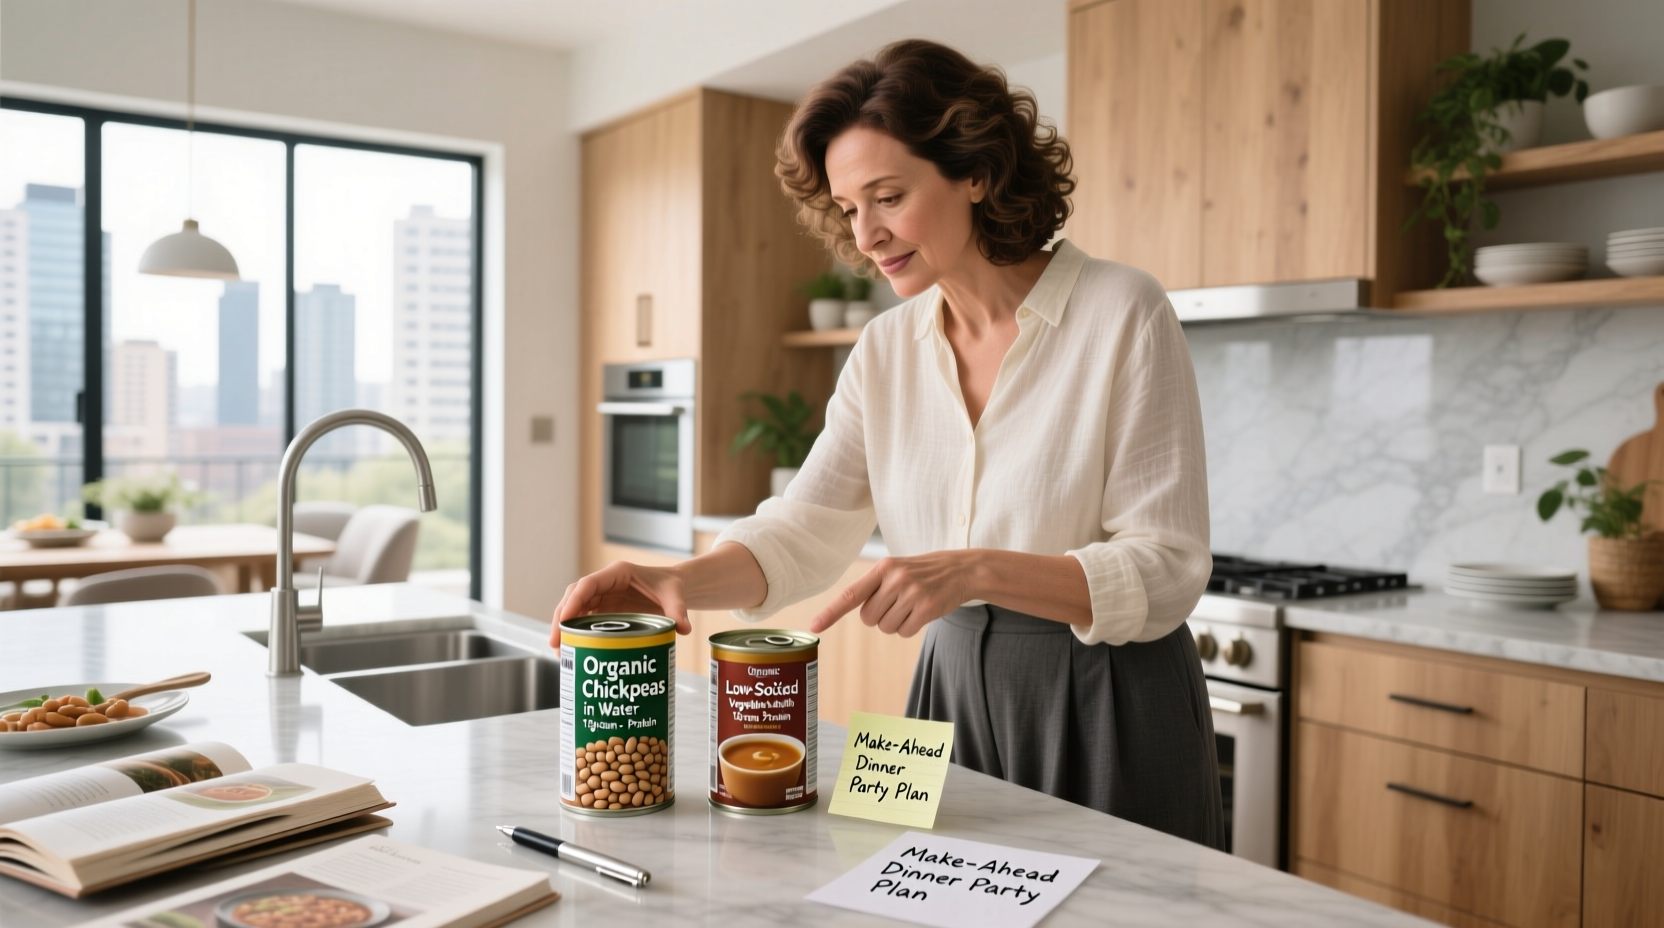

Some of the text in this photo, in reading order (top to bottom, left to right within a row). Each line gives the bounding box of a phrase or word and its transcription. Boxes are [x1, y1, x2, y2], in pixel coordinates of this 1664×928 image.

[583, 654, 657, 682] Organic
[582, 679, 666, 702] Chickpeas
[583, 701, 640, 717] in Water
[854, 731, 945, 758] Make-Ahead
[855, 754, 906, 775] Dinner
[849, 775, 929, 803] Party Plan
[900, 846, 1060, 883] Make-Ahead
[870, 879, 928, 901] Plan
[880, 861, 1041, 906] Dinner Party
